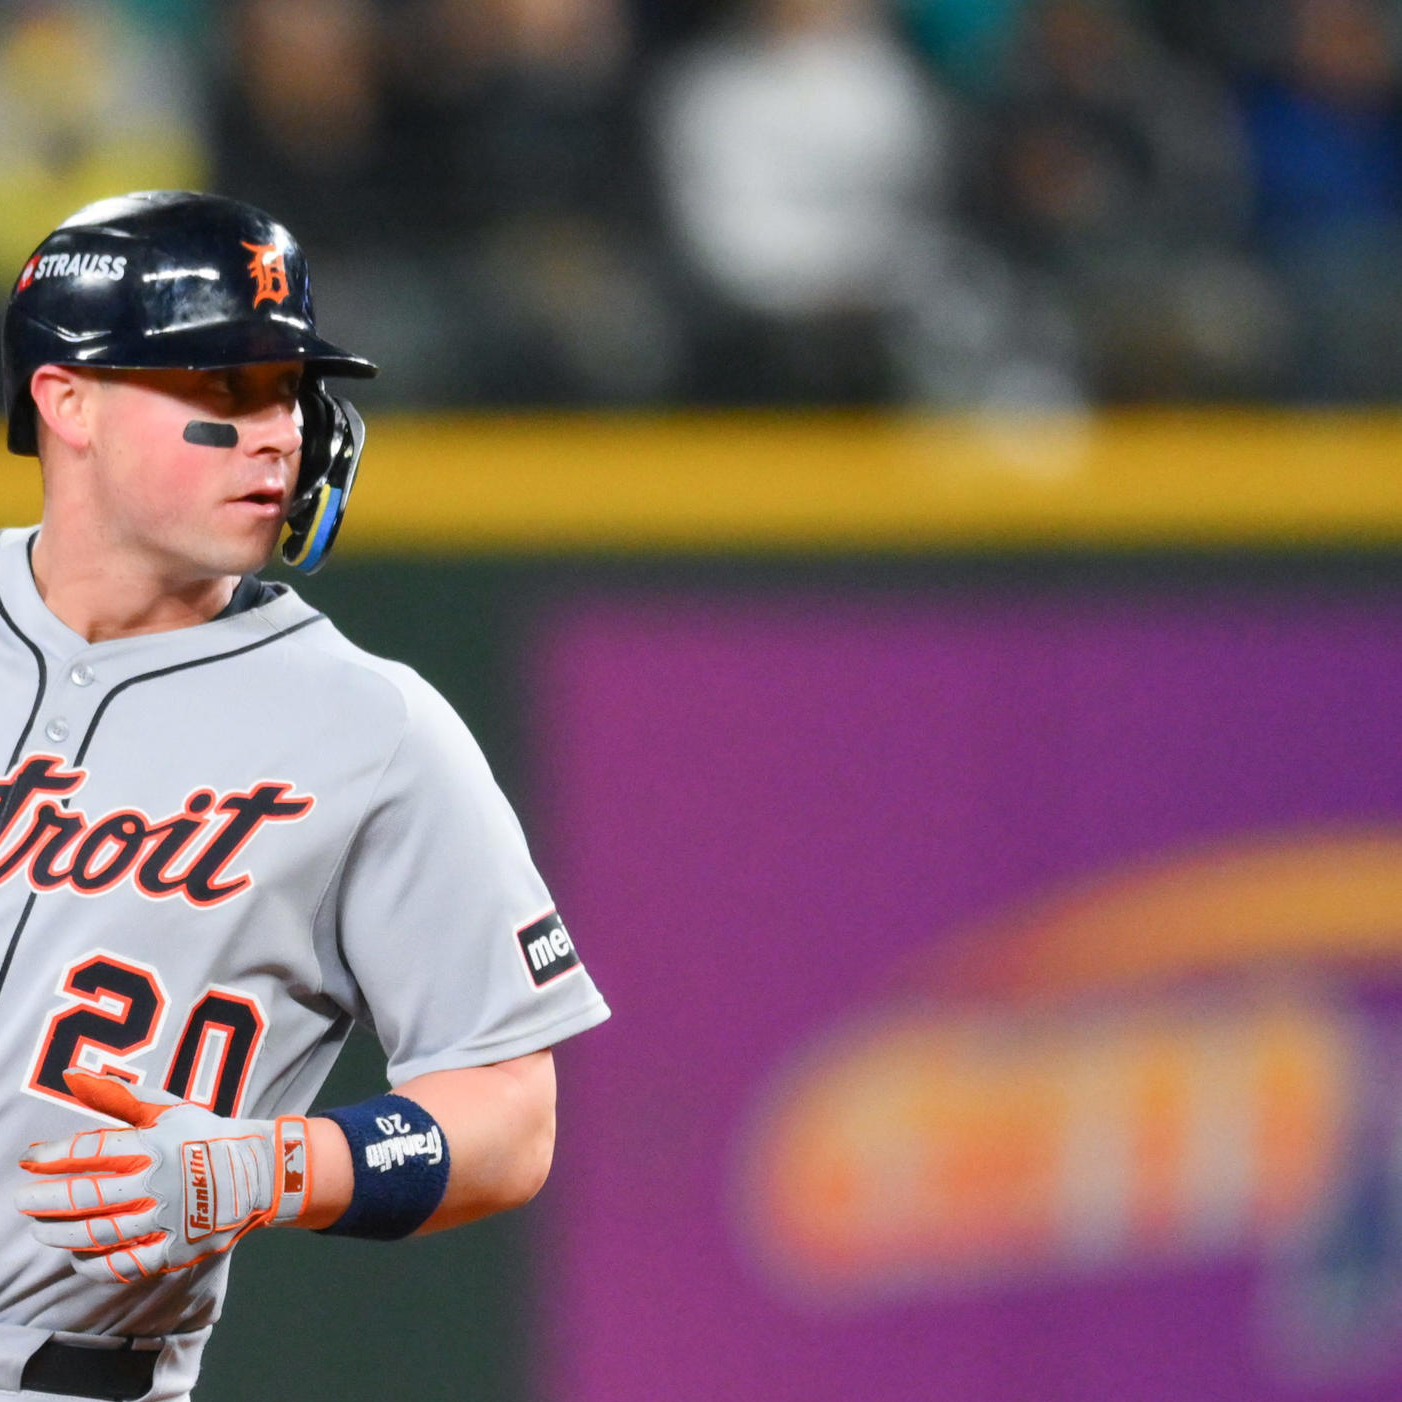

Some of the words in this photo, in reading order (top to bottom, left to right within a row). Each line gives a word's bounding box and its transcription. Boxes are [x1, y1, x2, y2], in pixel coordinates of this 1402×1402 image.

[34, 252, 128, 282] STRAUSS
[240, 240, 290, 310] D
[20, 947, 271, 1128] 20
[375, 1113, 411, 1135] 20
